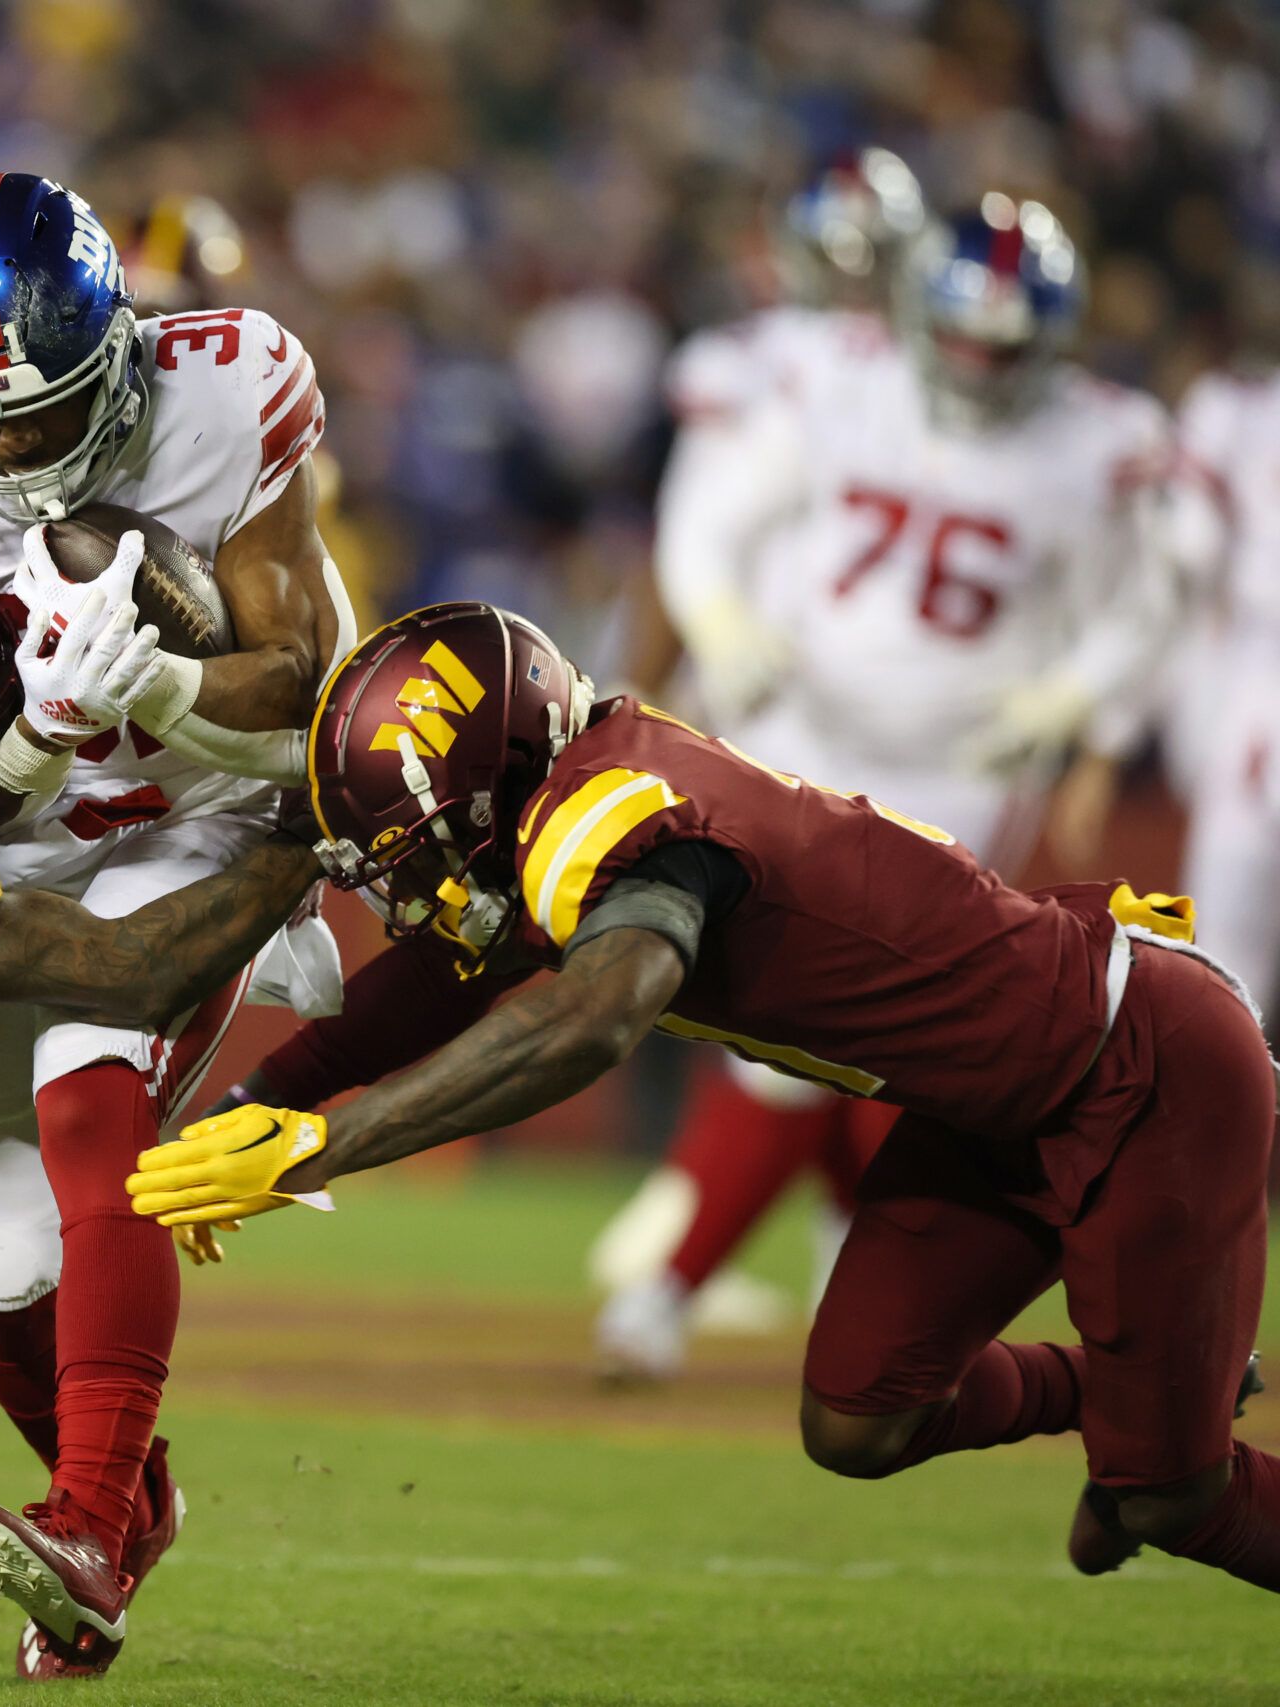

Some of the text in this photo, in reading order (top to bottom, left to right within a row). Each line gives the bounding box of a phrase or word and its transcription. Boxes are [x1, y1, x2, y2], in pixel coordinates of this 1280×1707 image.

[155, 309, 244, 371] 31
[829, 485, 1013, 640] 76
[39, 703, 100, 727] adidas
